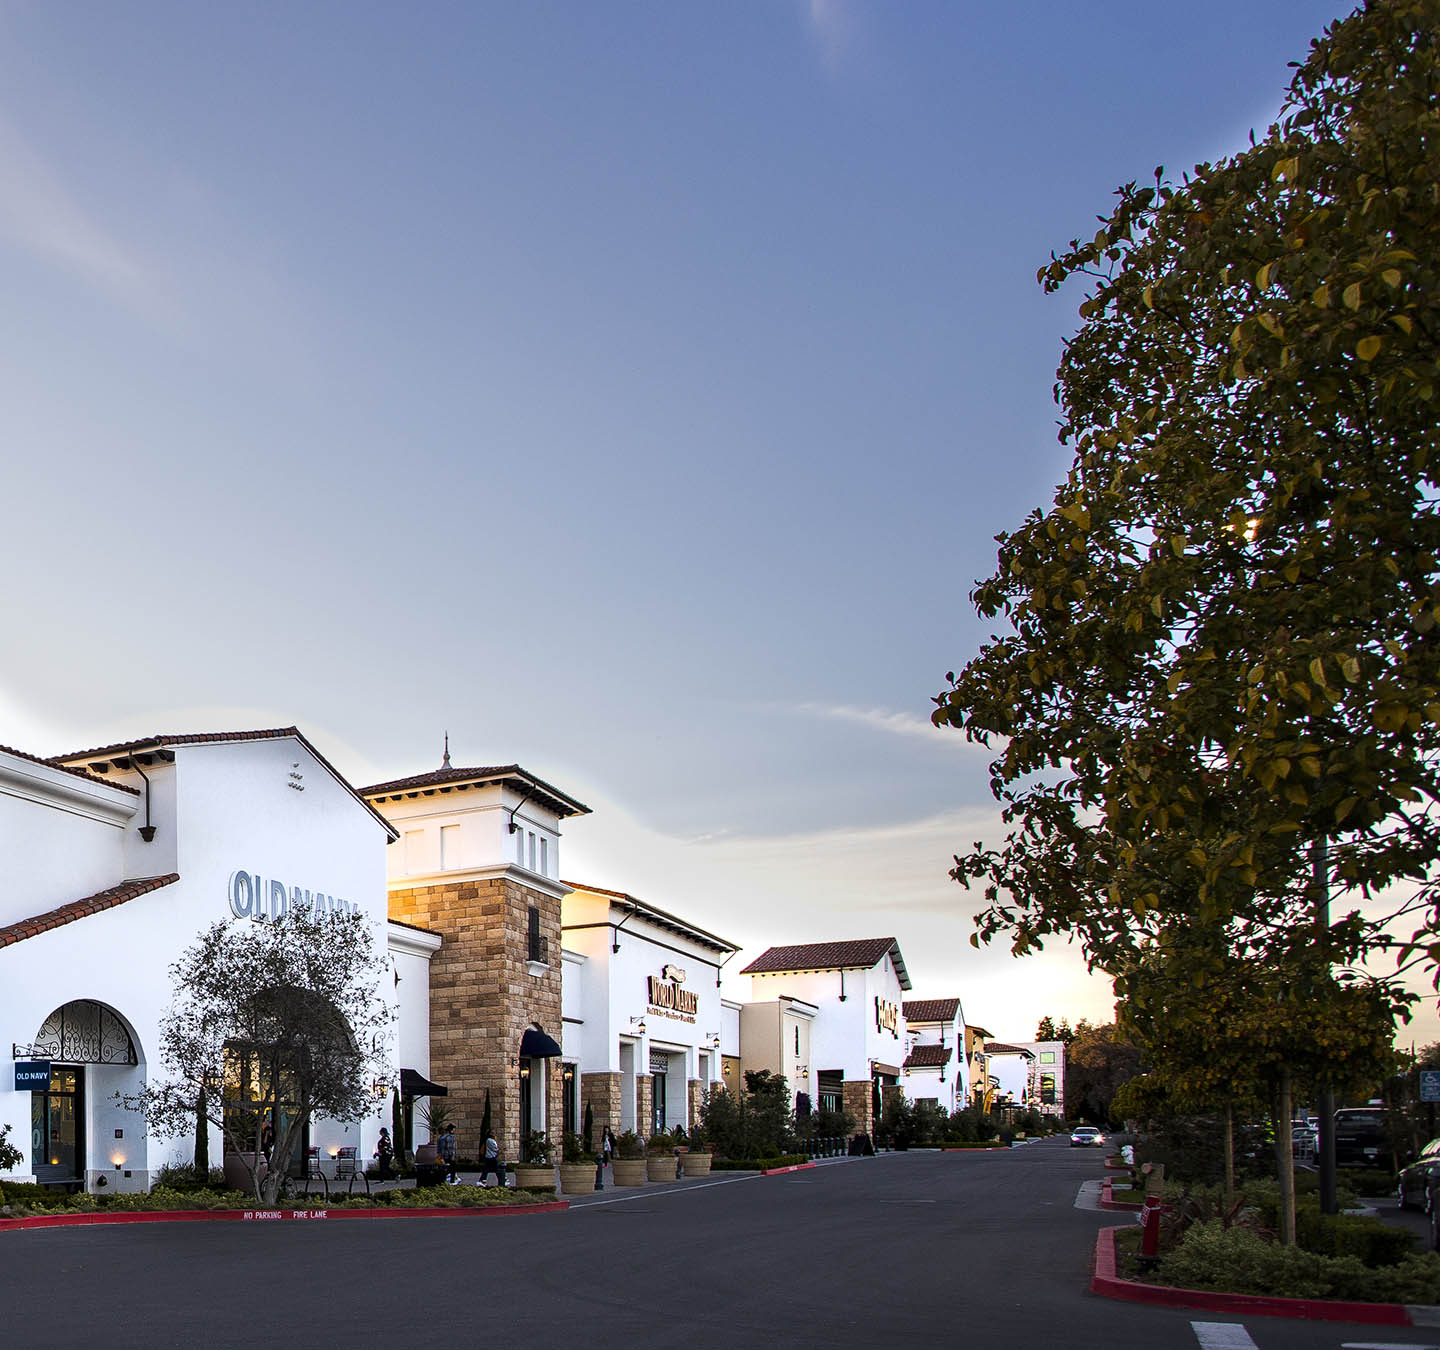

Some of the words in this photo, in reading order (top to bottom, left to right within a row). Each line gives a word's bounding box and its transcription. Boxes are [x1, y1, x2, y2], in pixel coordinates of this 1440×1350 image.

[228, 870, 287, 925] OLD
[647, 976, 675, 1009] WORLD
[675, 983, 699, 1015] MARKET
[16, 1072, 30, 1080] OLD
[30, 1072, 48, 1080] NAVY
[243, 1211, 253, 1220] NO
[255, 1211, 282, 1219] PARKING
[293, 1210, 308, 1219] FIRE
[310, 1210, 328, 1219] LANE
